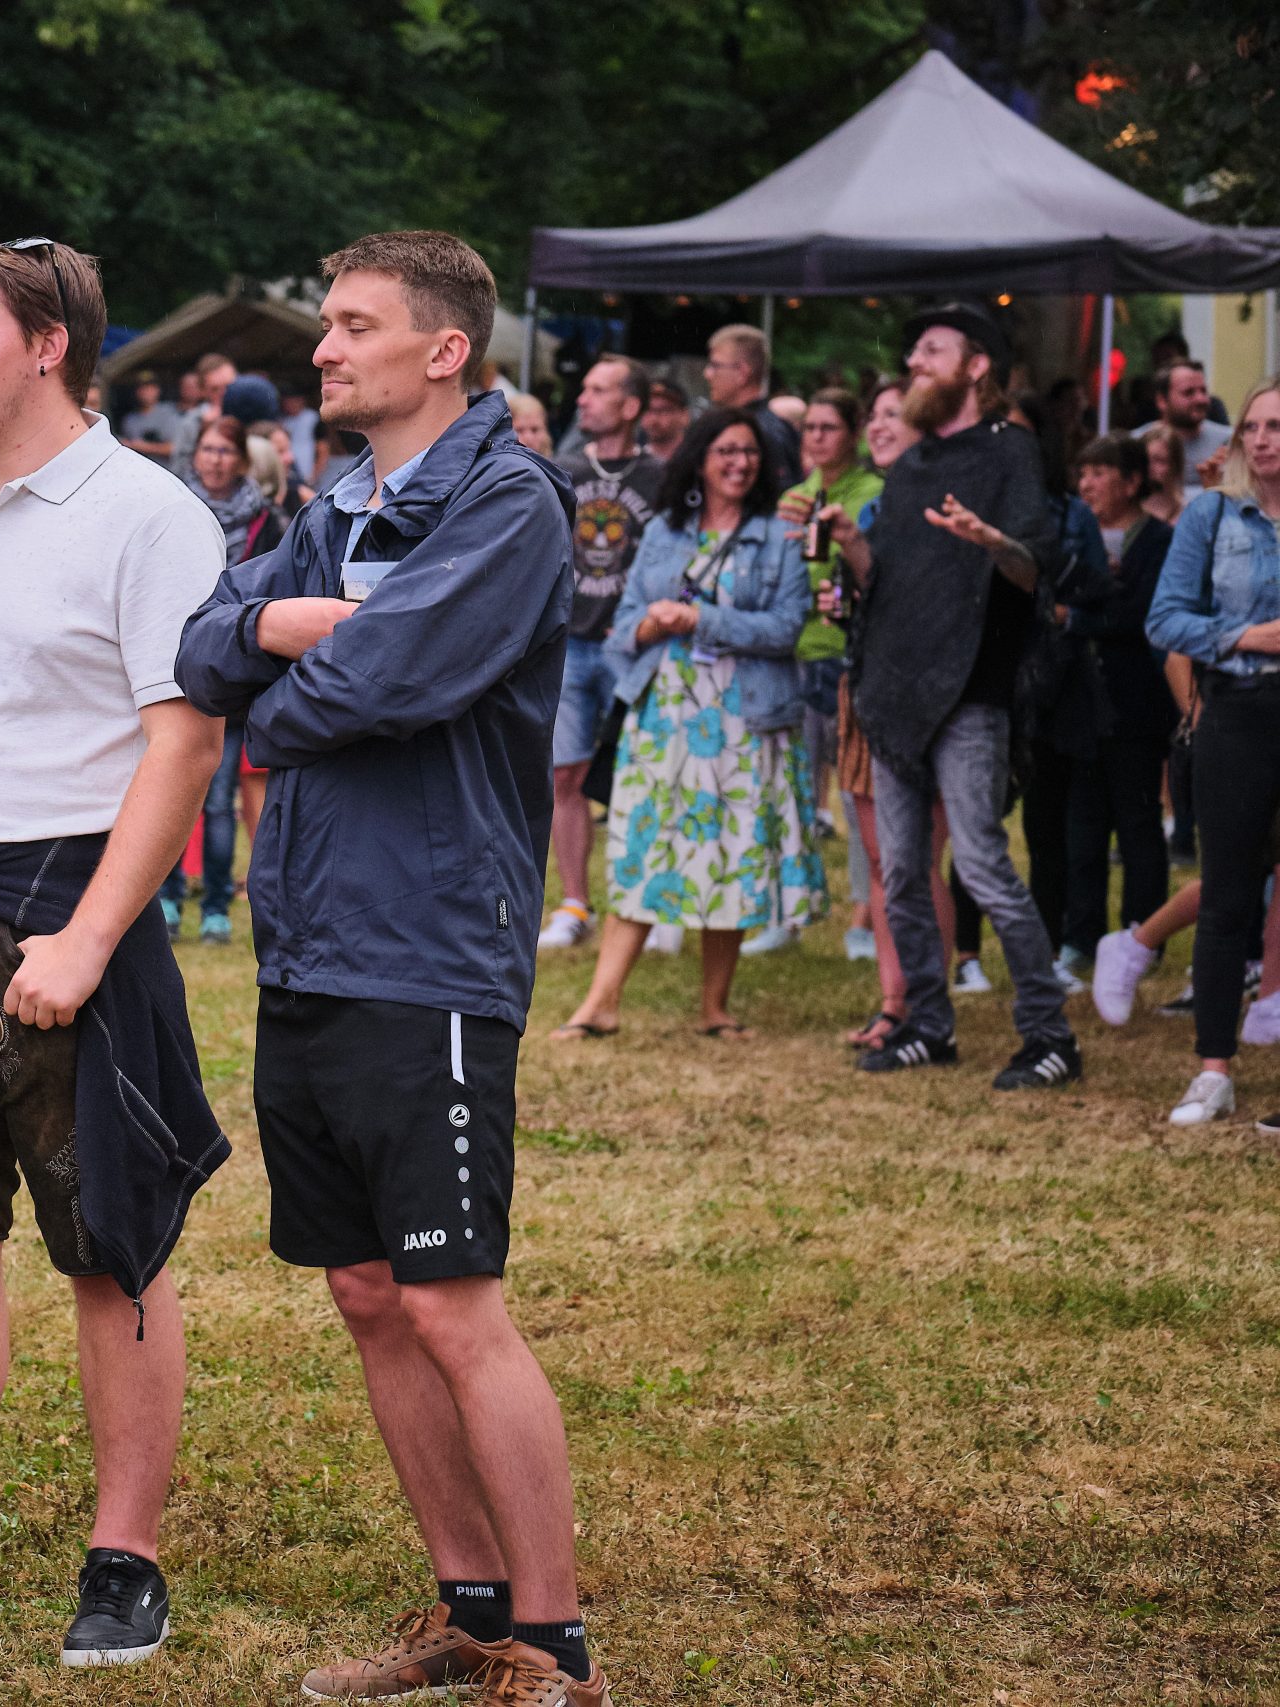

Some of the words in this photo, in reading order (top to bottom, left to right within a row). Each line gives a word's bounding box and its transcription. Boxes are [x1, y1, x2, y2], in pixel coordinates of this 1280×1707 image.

[403, 1229, 447, 1251] JAKO
[456, 1586, 495, 1598] PUMA
[565, 1625, 585, 1638] PUM
